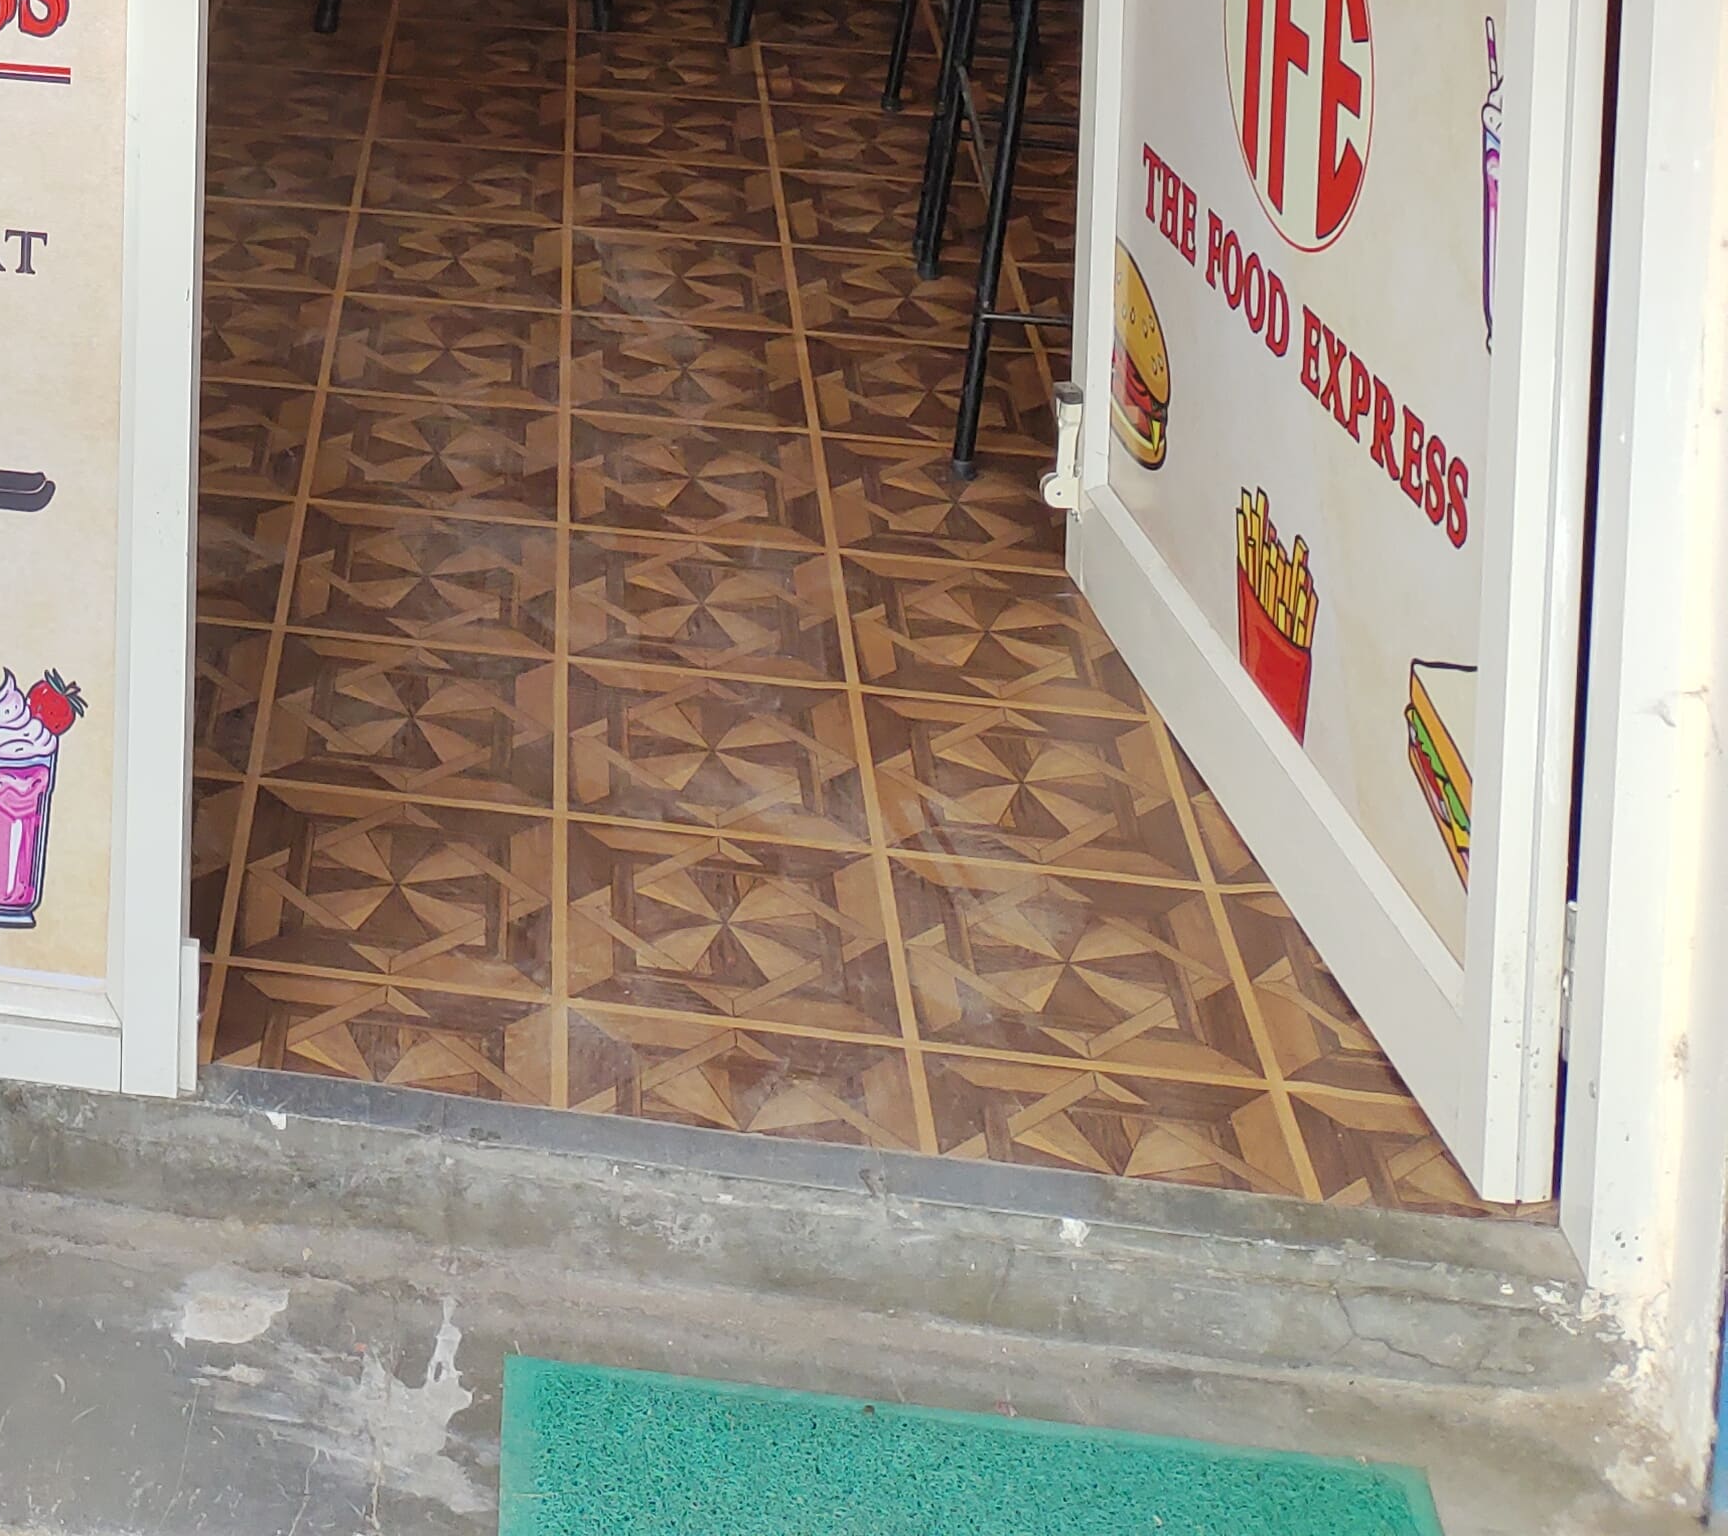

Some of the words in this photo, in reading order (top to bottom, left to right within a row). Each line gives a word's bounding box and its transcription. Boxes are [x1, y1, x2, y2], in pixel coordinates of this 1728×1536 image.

[1142, 141, 1197, 267] THE
[1205, 207, 1290, 358] FOOD
[1299, 303, 1469, 550] EXPRESS
